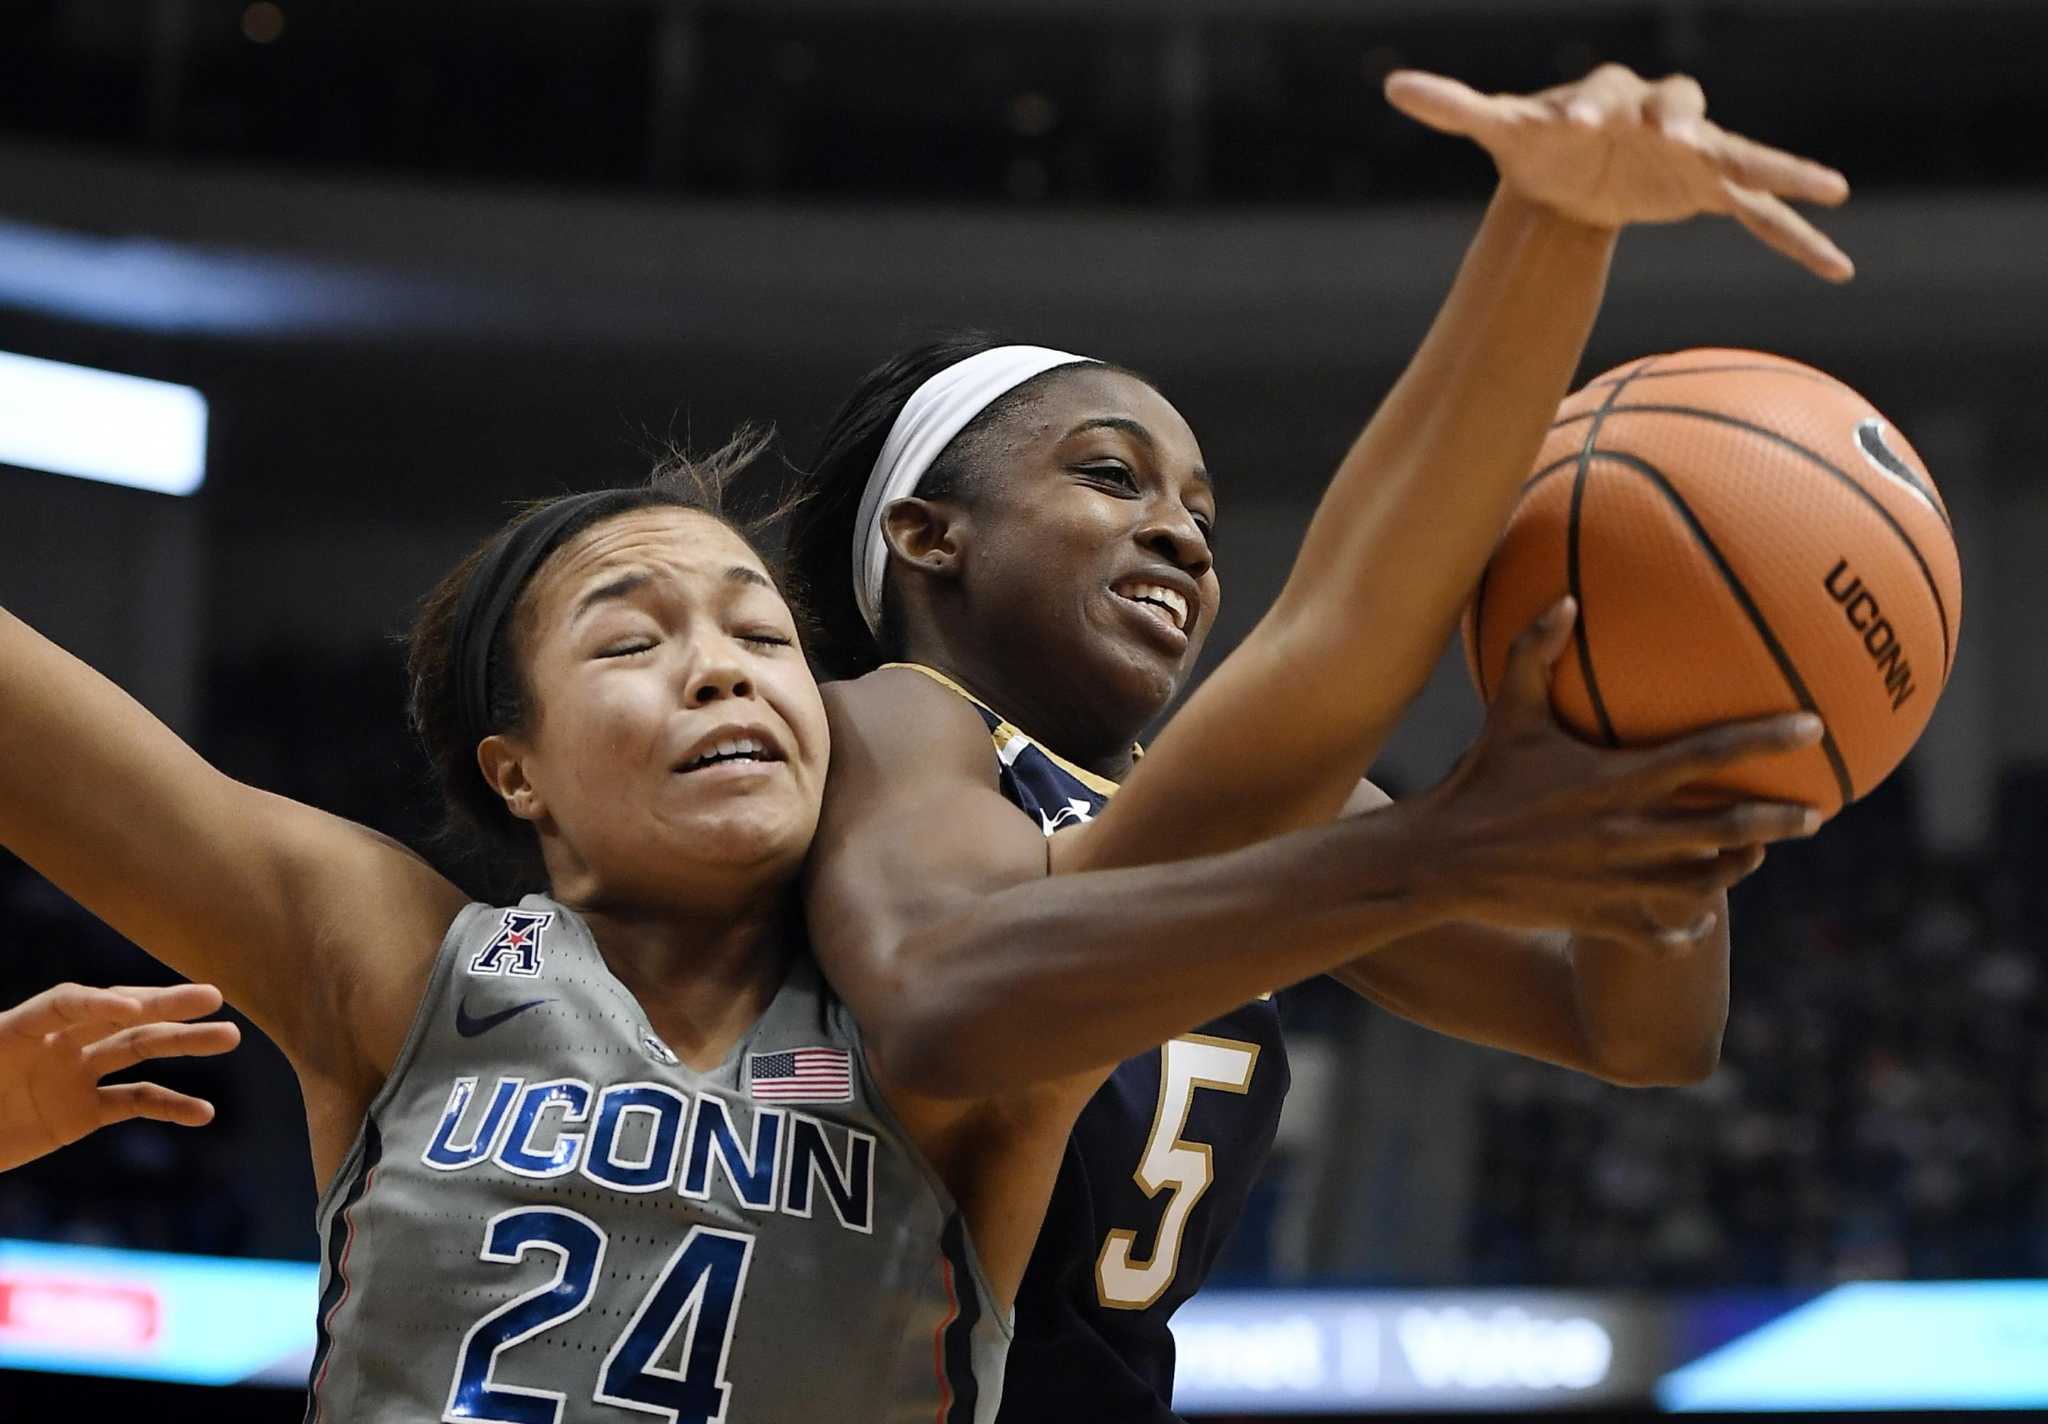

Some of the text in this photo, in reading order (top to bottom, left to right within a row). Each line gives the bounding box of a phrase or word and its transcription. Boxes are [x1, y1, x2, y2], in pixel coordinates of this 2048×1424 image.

[1824, 556, 1916, 713] UCONN
[469, 910, 553, 977] A
[420, 1076, 876, 1234] UCONN
[1095, 1032, 1261, 1310] 5
[442, 1205, 756, 1424] 24
